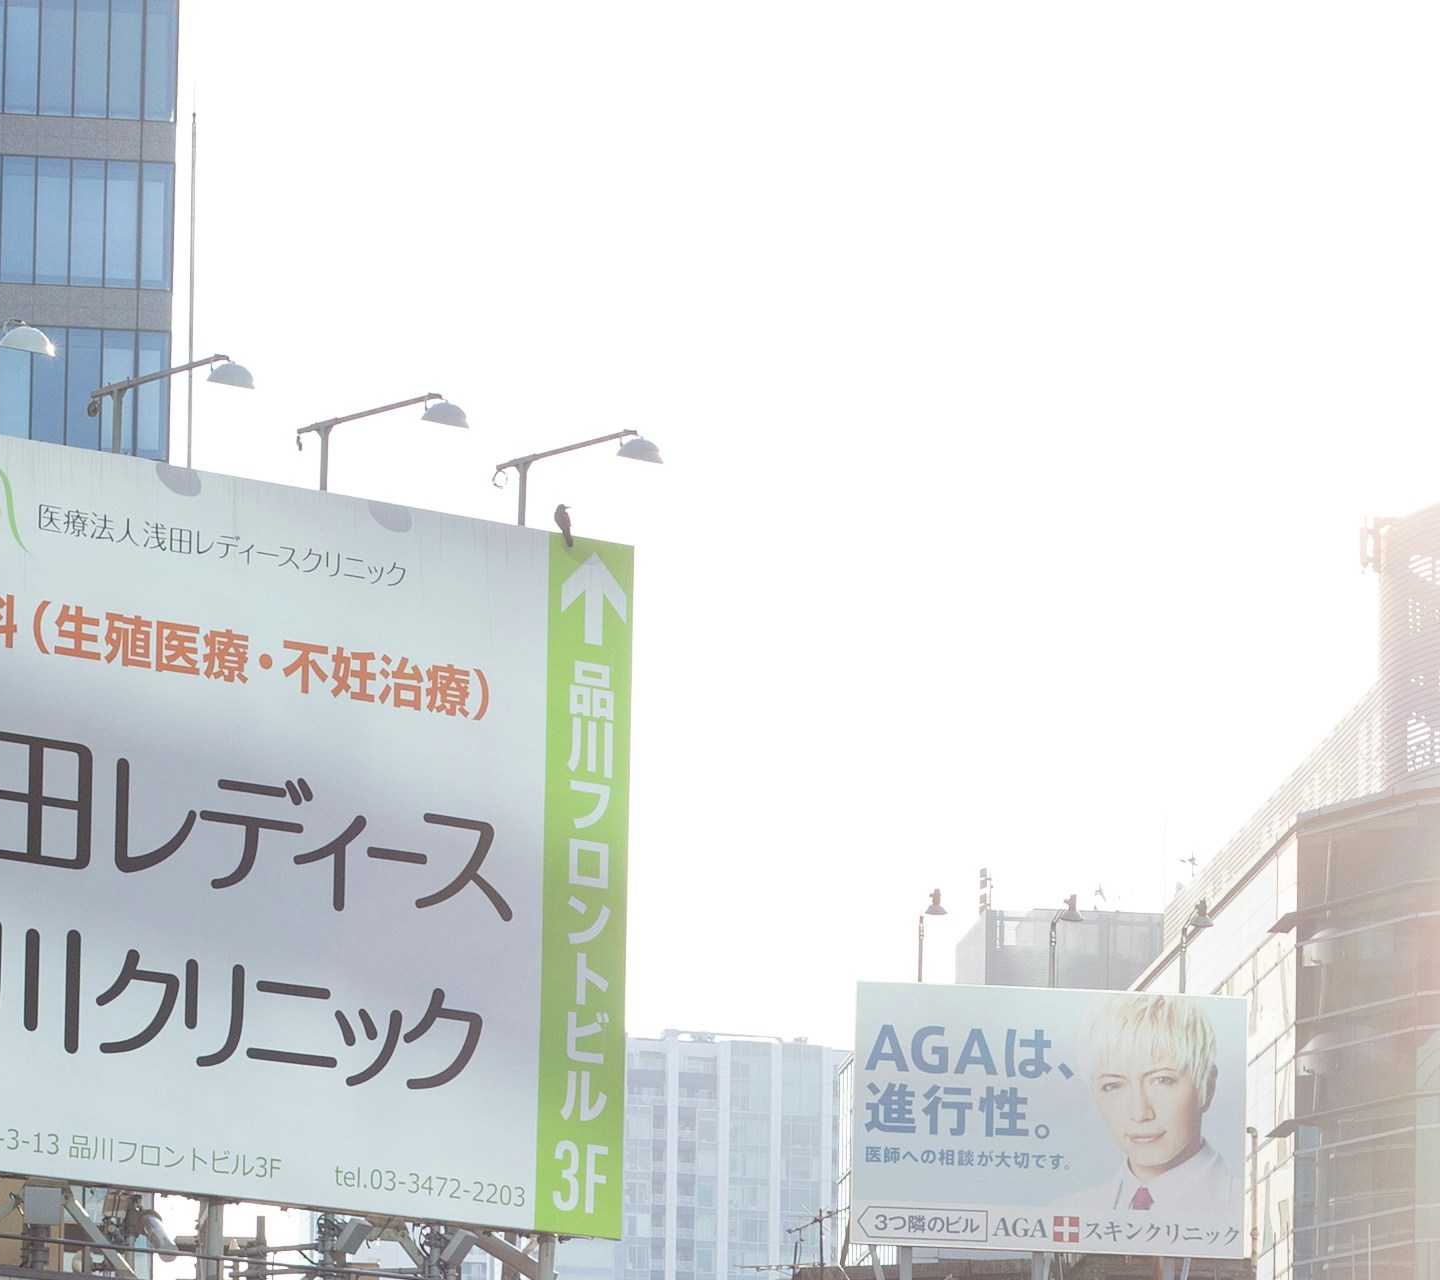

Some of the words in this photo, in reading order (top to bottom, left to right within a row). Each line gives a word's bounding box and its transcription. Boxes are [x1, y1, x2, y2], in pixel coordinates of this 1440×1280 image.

[37, 502, 408, 590] 医療法人浅田レディースクリニック
[559, 660, 618, 1122] 品川フロントビル
[864, 1023, 1076, 1081] AGAは、
[863, 1080, 1051, 1140] 進行性。
[68, 1133, 282, 1180] 品川フロントビル3F
[551, 1140, 609, 1214] 3F
[864, 1146, 1071, 1172] 医師への相談が大切です。
[334, 1165, 526, 1208] tel.03-3472-2203
[873, 1213, 981, 1235] 3つ隣のビル
[991, 1216, 1049, 1239] AGA
[1085, 1222, 1241, 1246] スキンクリニック
